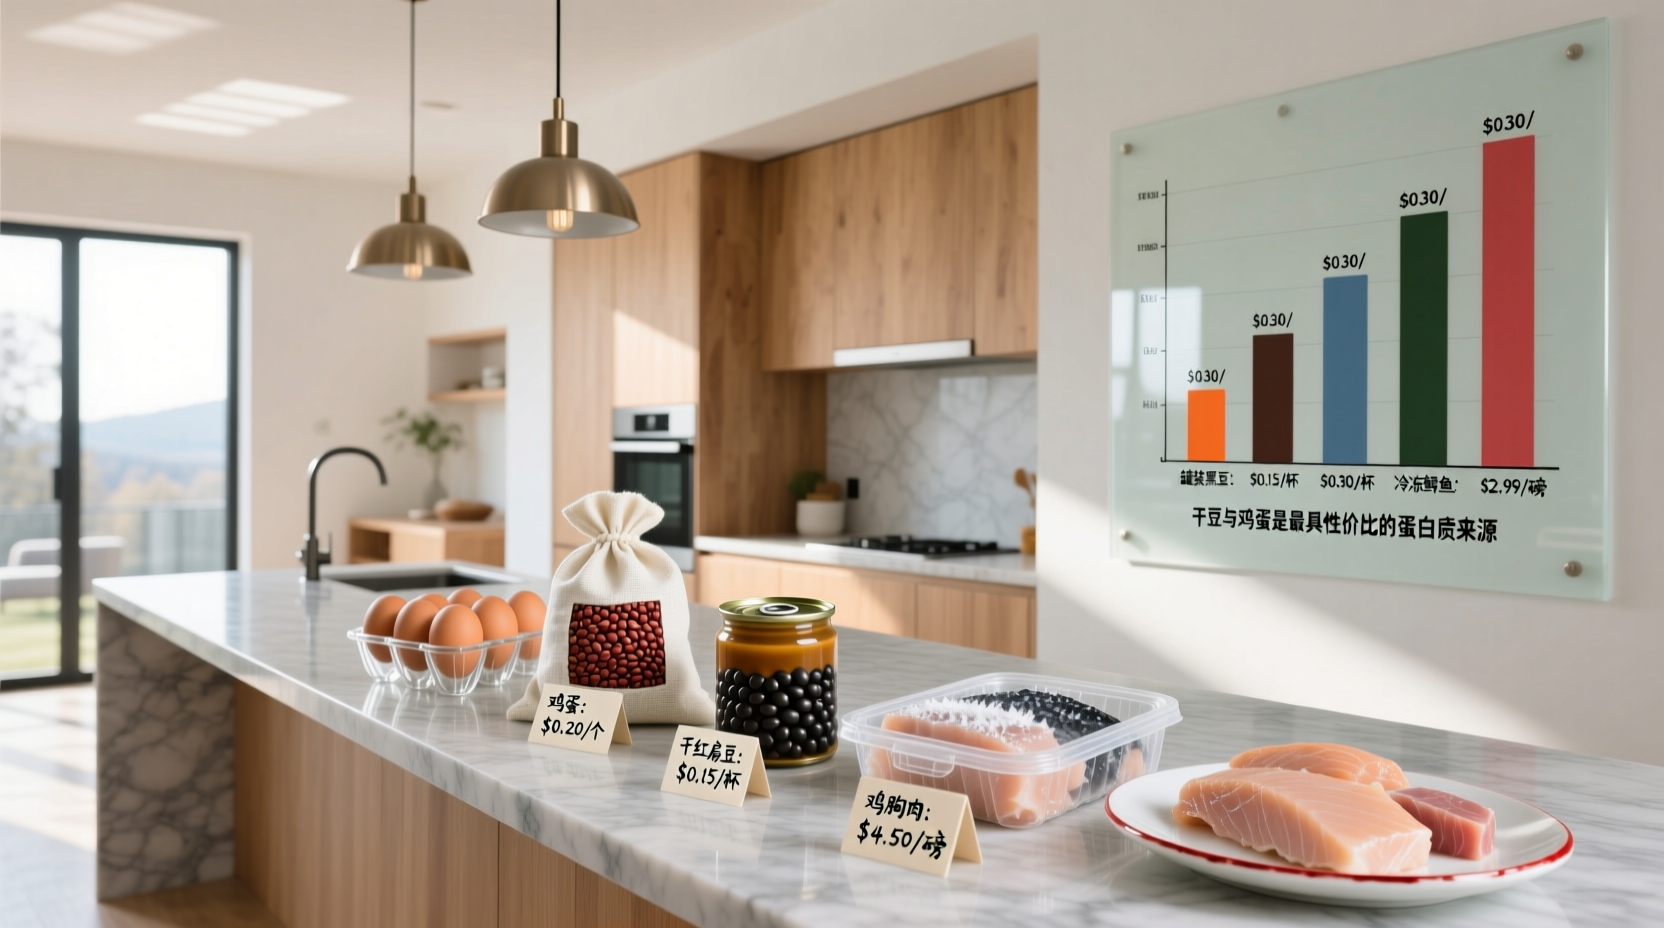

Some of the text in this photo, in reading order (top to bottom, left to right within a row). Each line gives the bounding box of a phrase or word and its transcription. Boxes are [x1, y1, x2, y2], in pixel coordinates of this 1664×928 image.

[1250, 472, 1299, 489] $0.15/杯
[1320, 473, 1375, 491] $0.30/杯
[1481, 477, 1548, 498] $2.99/磅
[1192, 506, 1498, 544] 干豆与鸡蛋是最具性价比的蛋白质来源
[540, 716, 605, 741] $0.20/个
[676, 761, 742, 791] $0.15/杯
[864, 790, 931, 822] 鸡胸肉：
[857, 818, 947, 860] $4.50/磅
